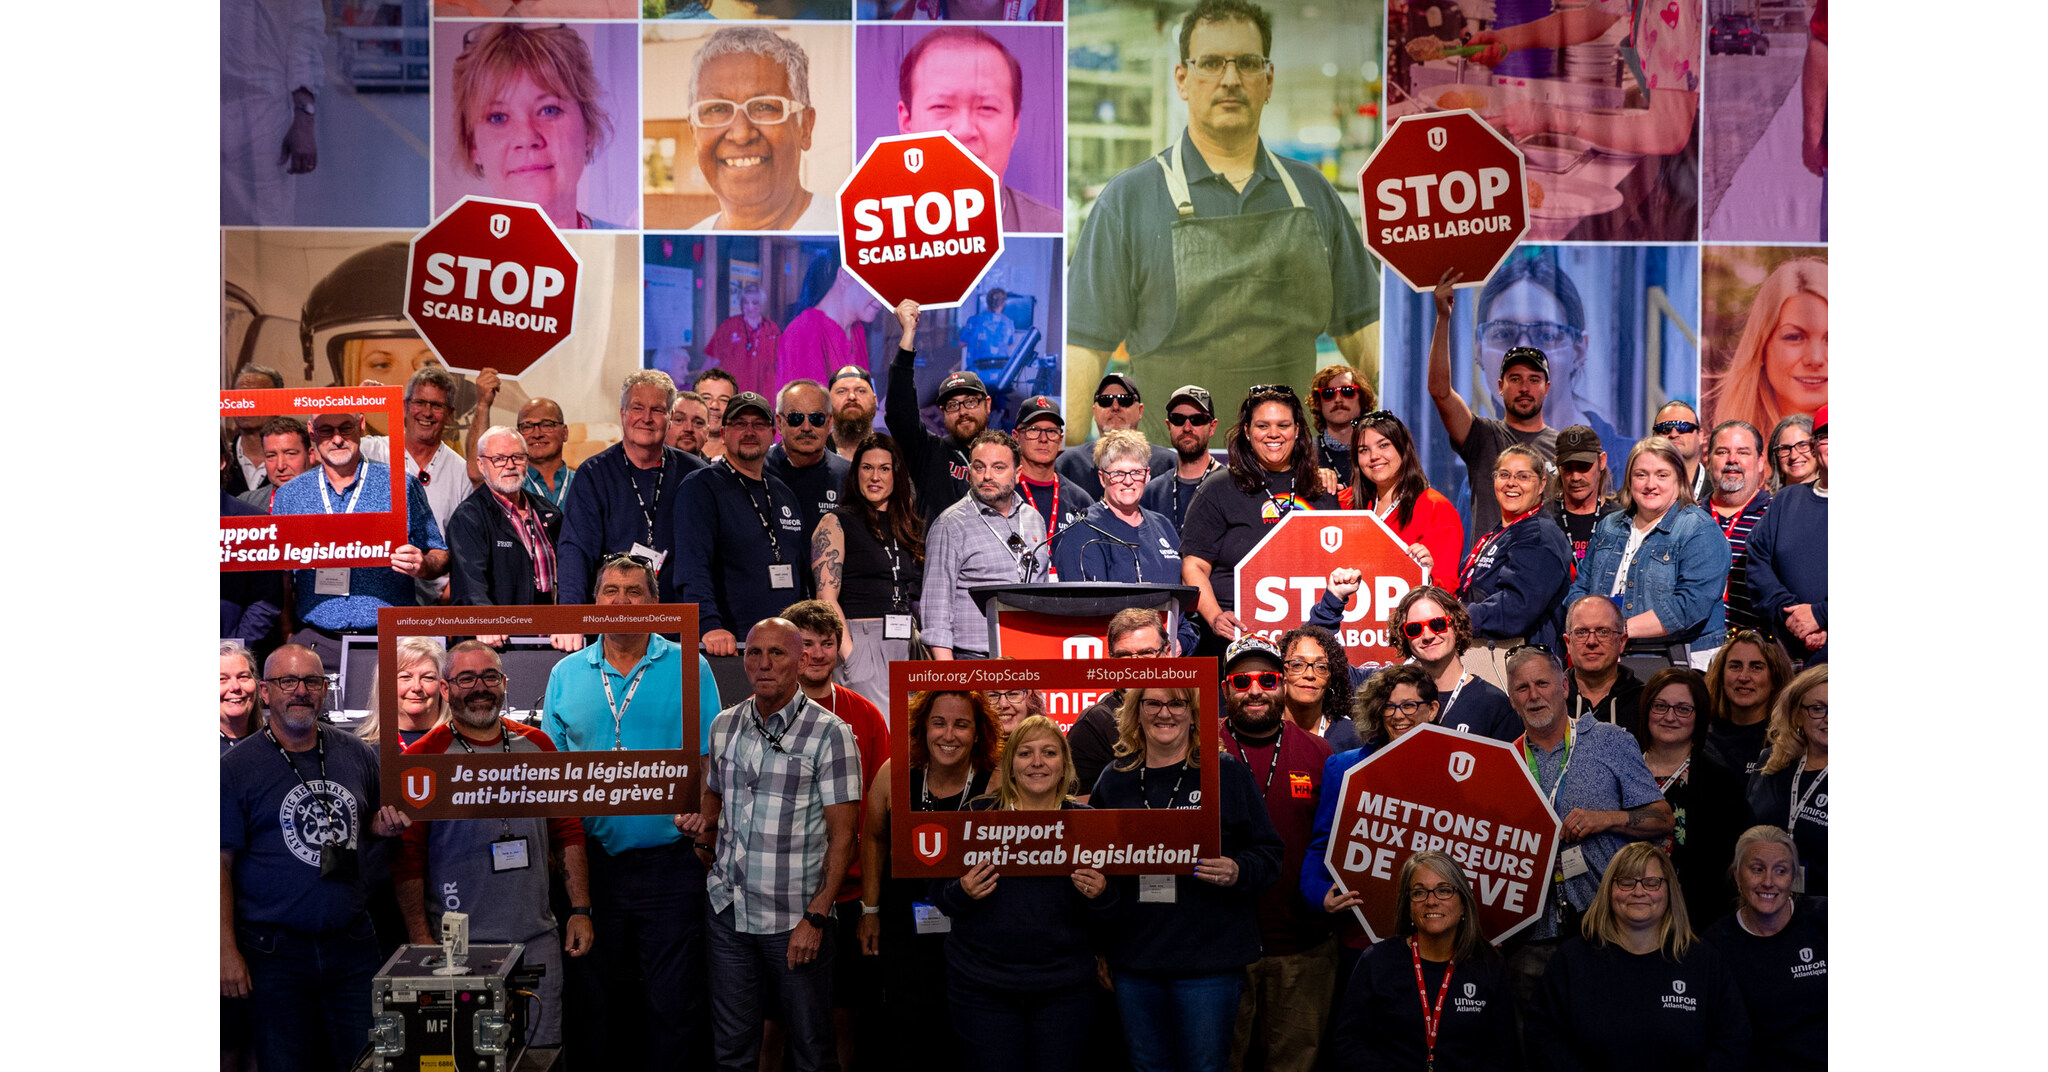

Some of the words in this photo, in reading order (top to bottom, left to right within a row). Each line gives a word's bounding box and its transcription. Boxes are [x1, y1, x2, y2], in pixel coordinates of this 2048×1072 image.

[1376, 167, 1510, 221] STOP
[853, 188, 985, 242] STOP
[1381, 224, 1430, 245] SCAB
[1434, 215, 1512, 239] LABOUR
[858, 244, 906, 266] SCAB
[909, 236, 986, 260] LABOUR
[423, 252, 565, 309] STOP
[422, 301, 474, 322] SCAB
[477, 308, 558, 334] LABOUR
[293, 395, 387, 409] #StopScabLabour
[283, 541, 392, 565] legislation!
[1254, 576, 1410, 623] STOP
[396, 615, 533, 627] unifor.org/NonAuxBriseursDeGreve
[582, 614, 682, 624] #NonAuxBriseursDeGreve
[1334, 629, 1390, 647] ABOU
[908, 668, 1040, 685] unifor.org/StopScabs
[1086, 667, 1198, 683] #StopScabLabour
[451, 764, 474, 784] Je
[477, 763, 561, 783] soutiens
[564, 762, 584, 780] la
[587, 759, 689, 783] législation
[293, 783, 345, 800] REIONAL
[406, 774, 431, 802] U
[451, 785, 579, 806] anti-briseurs
[582, 784, 606, 802] de
[608, 783, 663, 806] grève
[1294, 785, 1310, 795] HH
[1356, 790, 1491, 842] METTONS
[1495, 824, 1542, 855] FIN
[1801, 806, 1828, 819] UNIFO
[918, 831, 941, 858] U
[963, 821, 972, 840] I
[976, 820, 1064, 844] support
[963, 845, 1067, 867] anti-scab
[1072, 844, 1200, 869] legislation!
[1343, 840, 1396, 881] DE
[1350, 817, 1407, 848] AUX
[1410, 831, 1535, 879] BRISEURS
[1661, 995, 1697, 1006] UNIFOR
